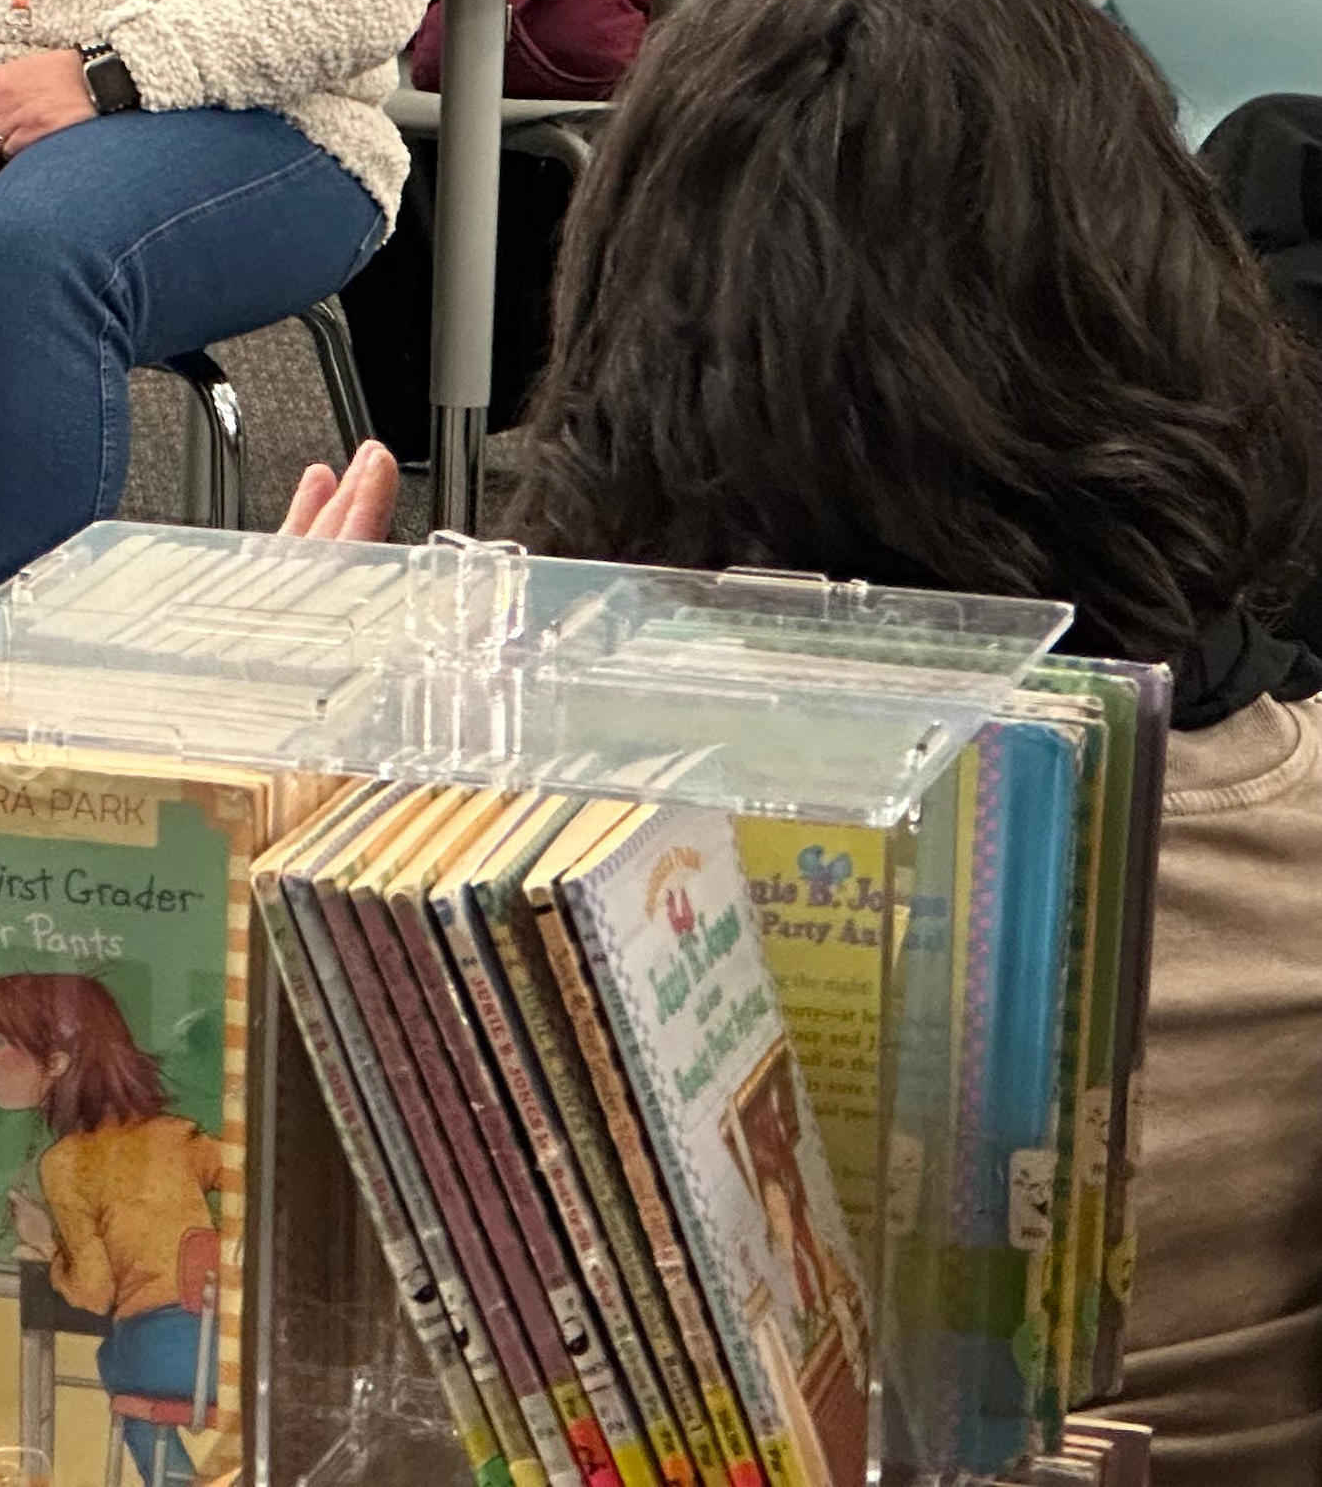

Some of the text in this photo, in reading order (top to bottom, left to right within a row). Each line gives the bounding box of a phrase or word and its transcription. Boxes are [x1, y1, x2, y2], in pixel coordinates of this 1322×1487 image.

[49, 783, 146, 828] PARK
[64, 867, 206, 913] Grader
[26, 912, 124, 959] Pants
[762, 912, 832, 945] Party
[468, 972, 507, 1040] JUNIE
[505, 1063, 544, 1130] JONES
